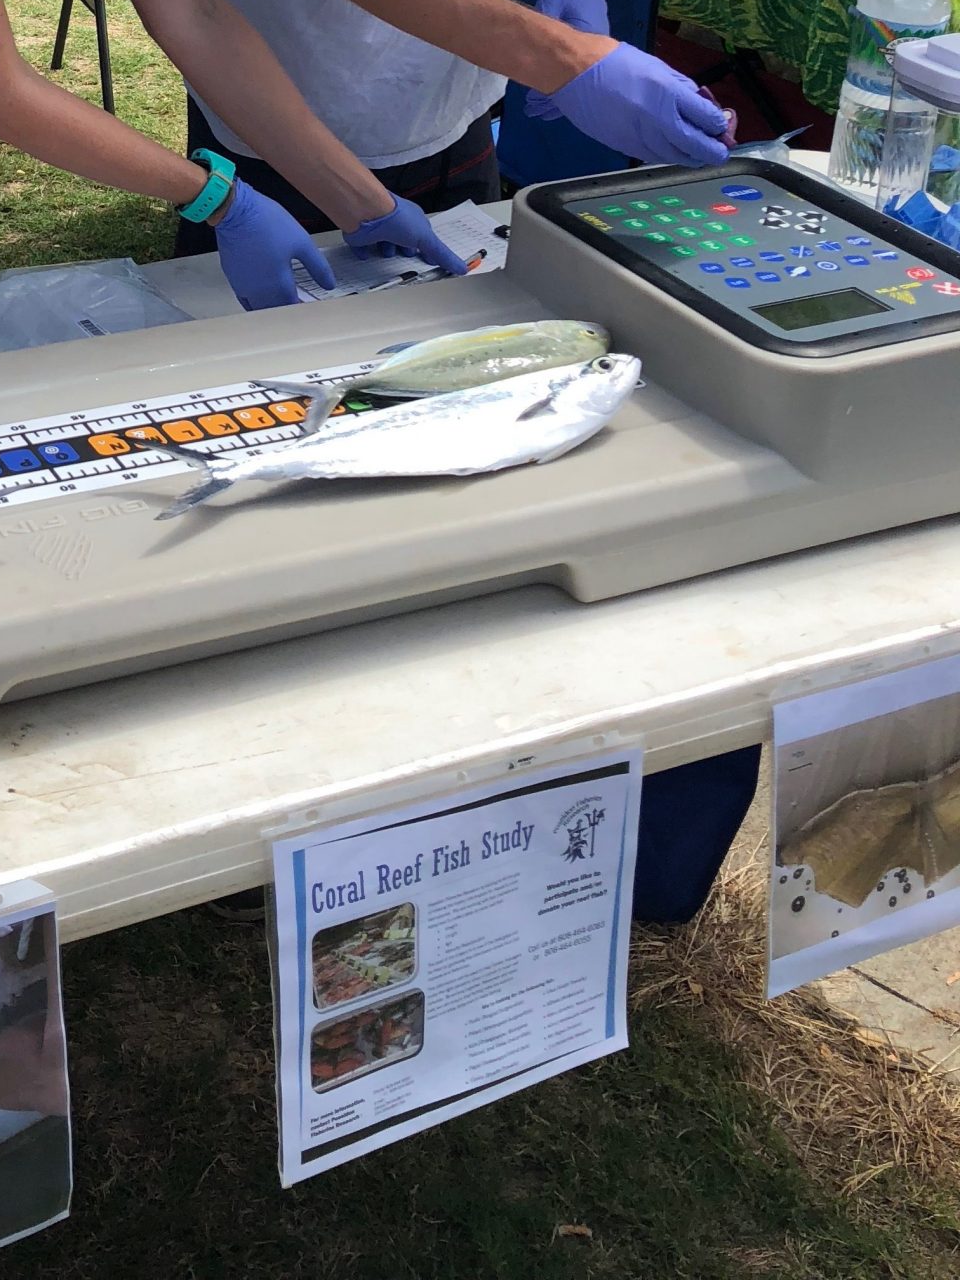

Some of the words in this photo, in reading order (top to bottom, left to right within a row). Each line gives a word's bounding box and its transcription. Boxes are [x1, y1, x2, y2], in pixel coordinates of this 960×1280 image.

[10, 424, 27, 432] 50
[219, 422, 233, 431] K
[110, 442, 125, 451] N
[20, 459, 33, 468] P
[122, 472, 139, 480] 45
[60, 484, 77, 493] 50
[311, 871, 366, 913] Coral
[376, 853, 424, 895] Reef
[432, 840, 471, 877] Fish
[481, 821, 535, 860] Study
[547, 880, 566, 890] Would
[567, 877, 579, 886] you
[544, 888, 579, 904] participate
[538, 905, 560, 915] donate
[561, 900, 575, 909] your
[576, 894, 590, 902] reef
[321, 1111, 334, 1119] more
[310, 1119, 330, 1131] contact
[331, 1110, 355, 1122] Poseidon
[310, 1125, 335, 1138] Fisheries
